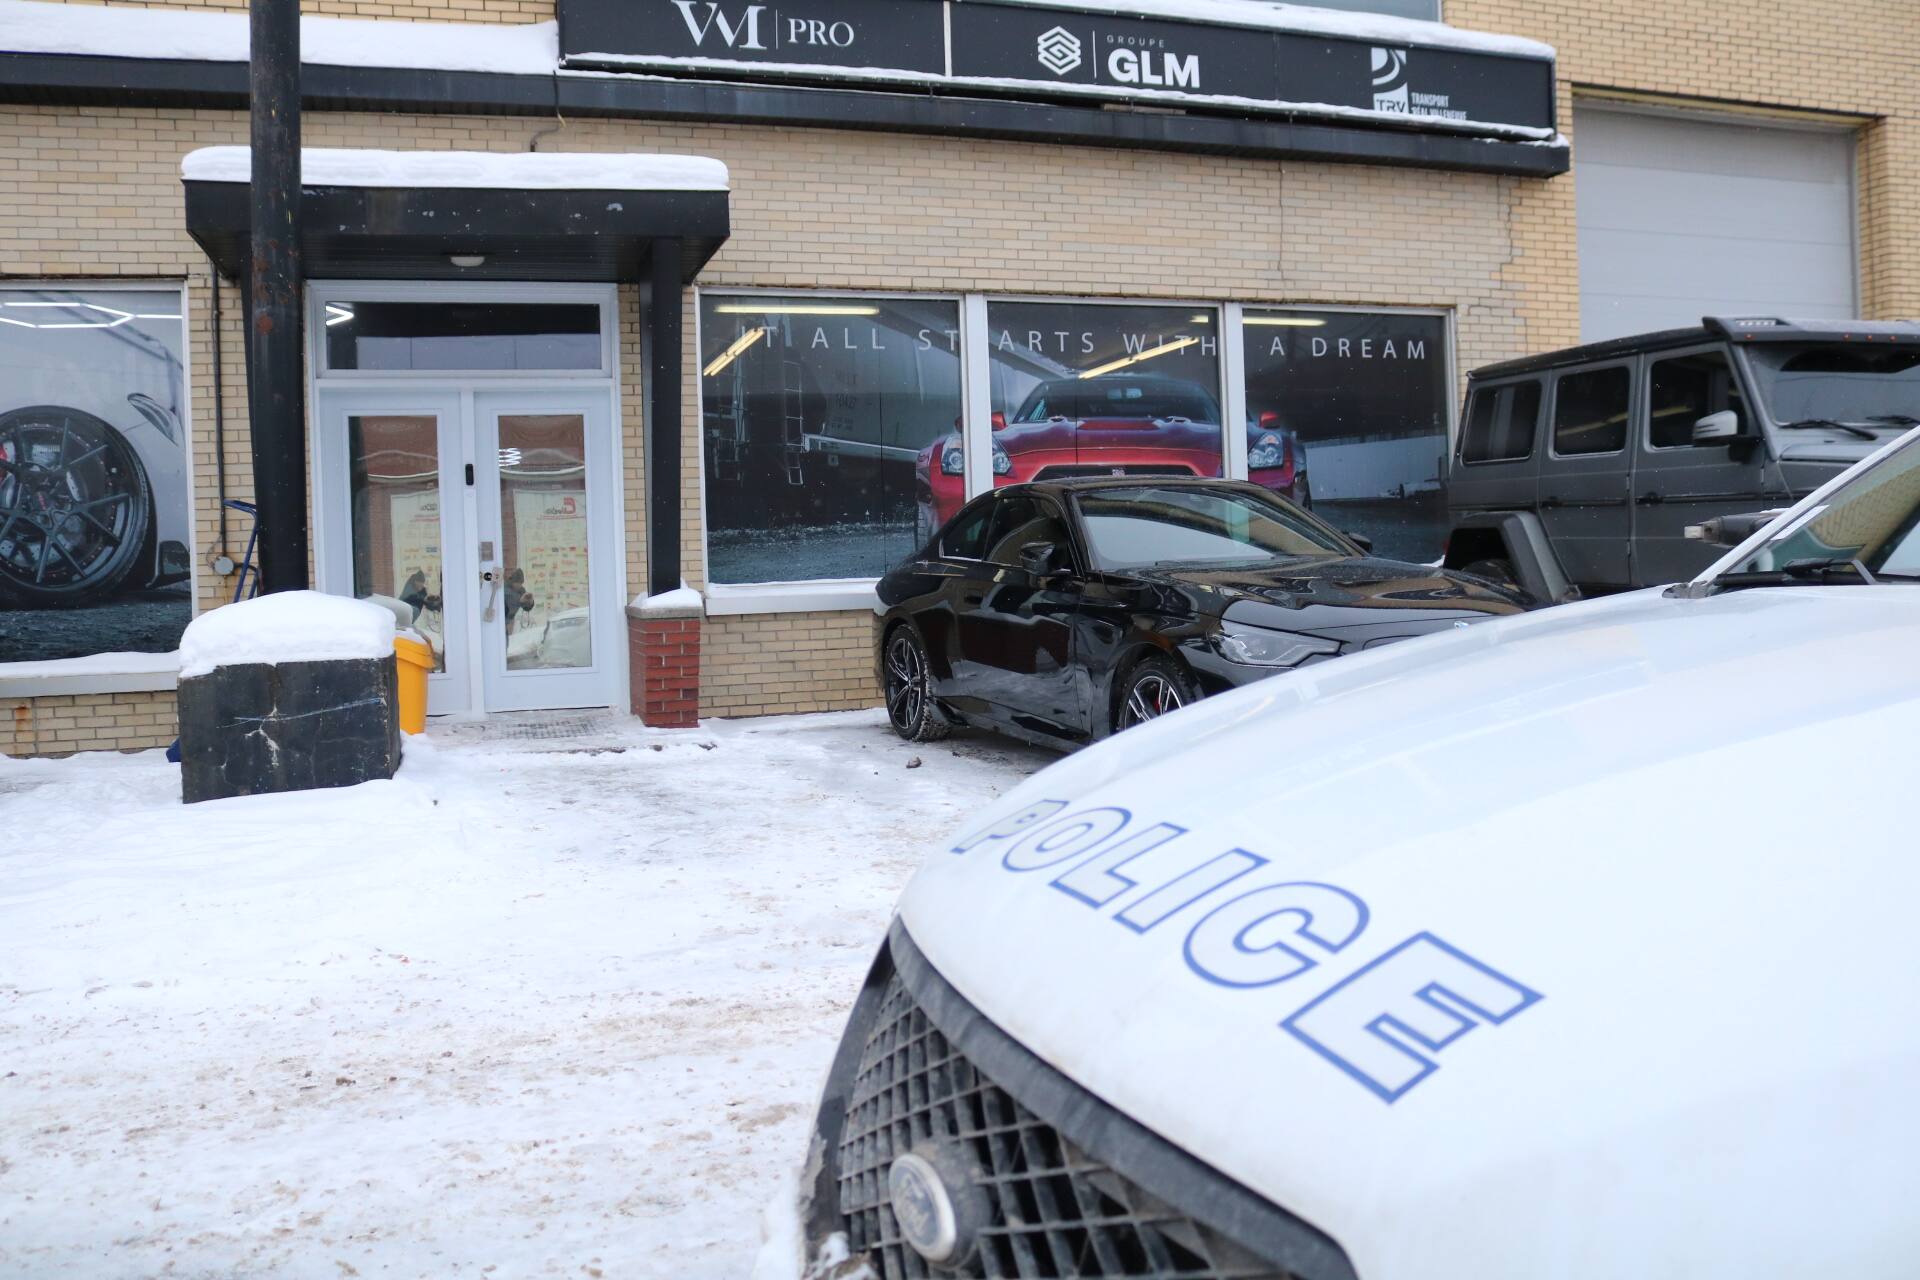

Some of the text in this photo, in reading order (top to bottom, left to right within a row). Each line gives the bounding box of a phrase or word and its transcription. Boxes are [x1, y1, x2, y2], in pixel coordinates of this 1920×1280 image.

[787, 18, 855, 47] PRO
[1106, 34, 1165, 48] GROUPE
[1107, 47, 1201, 89] GLM
[1376, 99, 1406, 113] TRV
[1411, 92, 1449, 108] TRANSPORT
[811, 327, 886, 349] ALL
[1122, 333, 1217, 356] WITH
[1269, 336, 1285, 356] A
[1311, 337, 1425, 360] DREAM
[950, 798, 1545, 1104] POLICE
